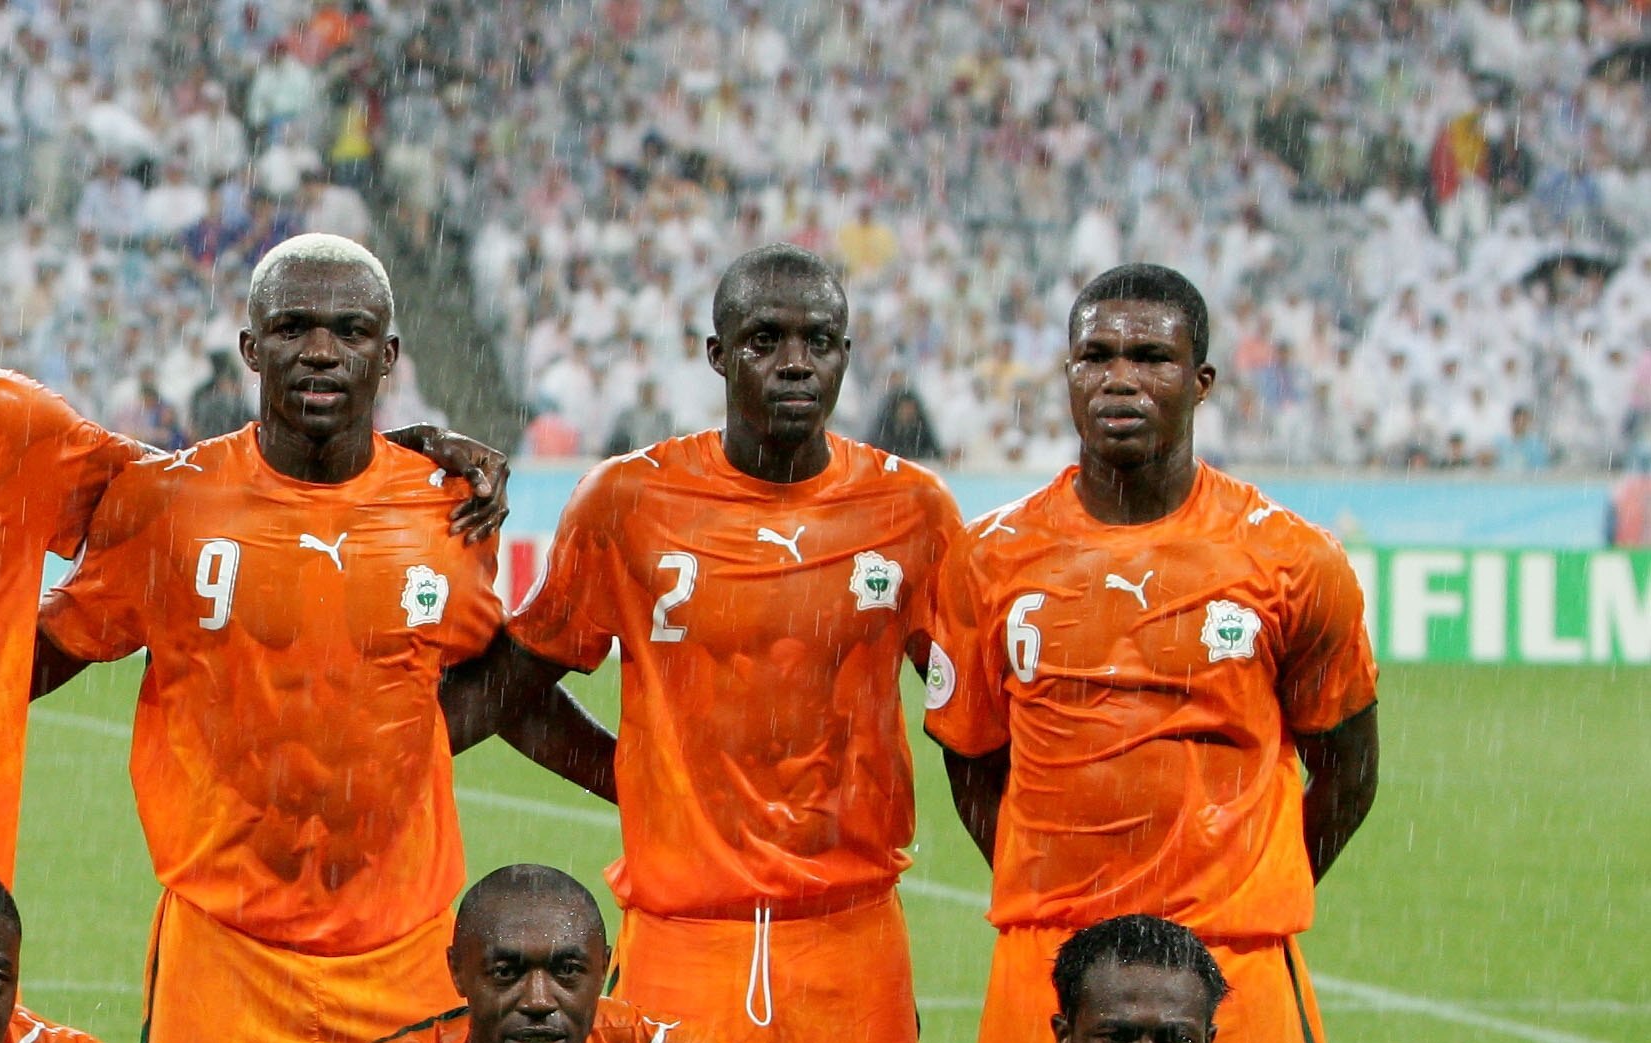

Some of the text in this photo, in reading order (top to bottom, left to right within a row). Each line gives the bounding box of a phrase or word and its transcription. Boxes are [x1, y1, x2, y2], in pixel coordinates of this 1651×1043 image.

[195, 538, 241, 631] 9
[650, 550, 698, 643] 2
[1006, 592, 1046, 683] 6
